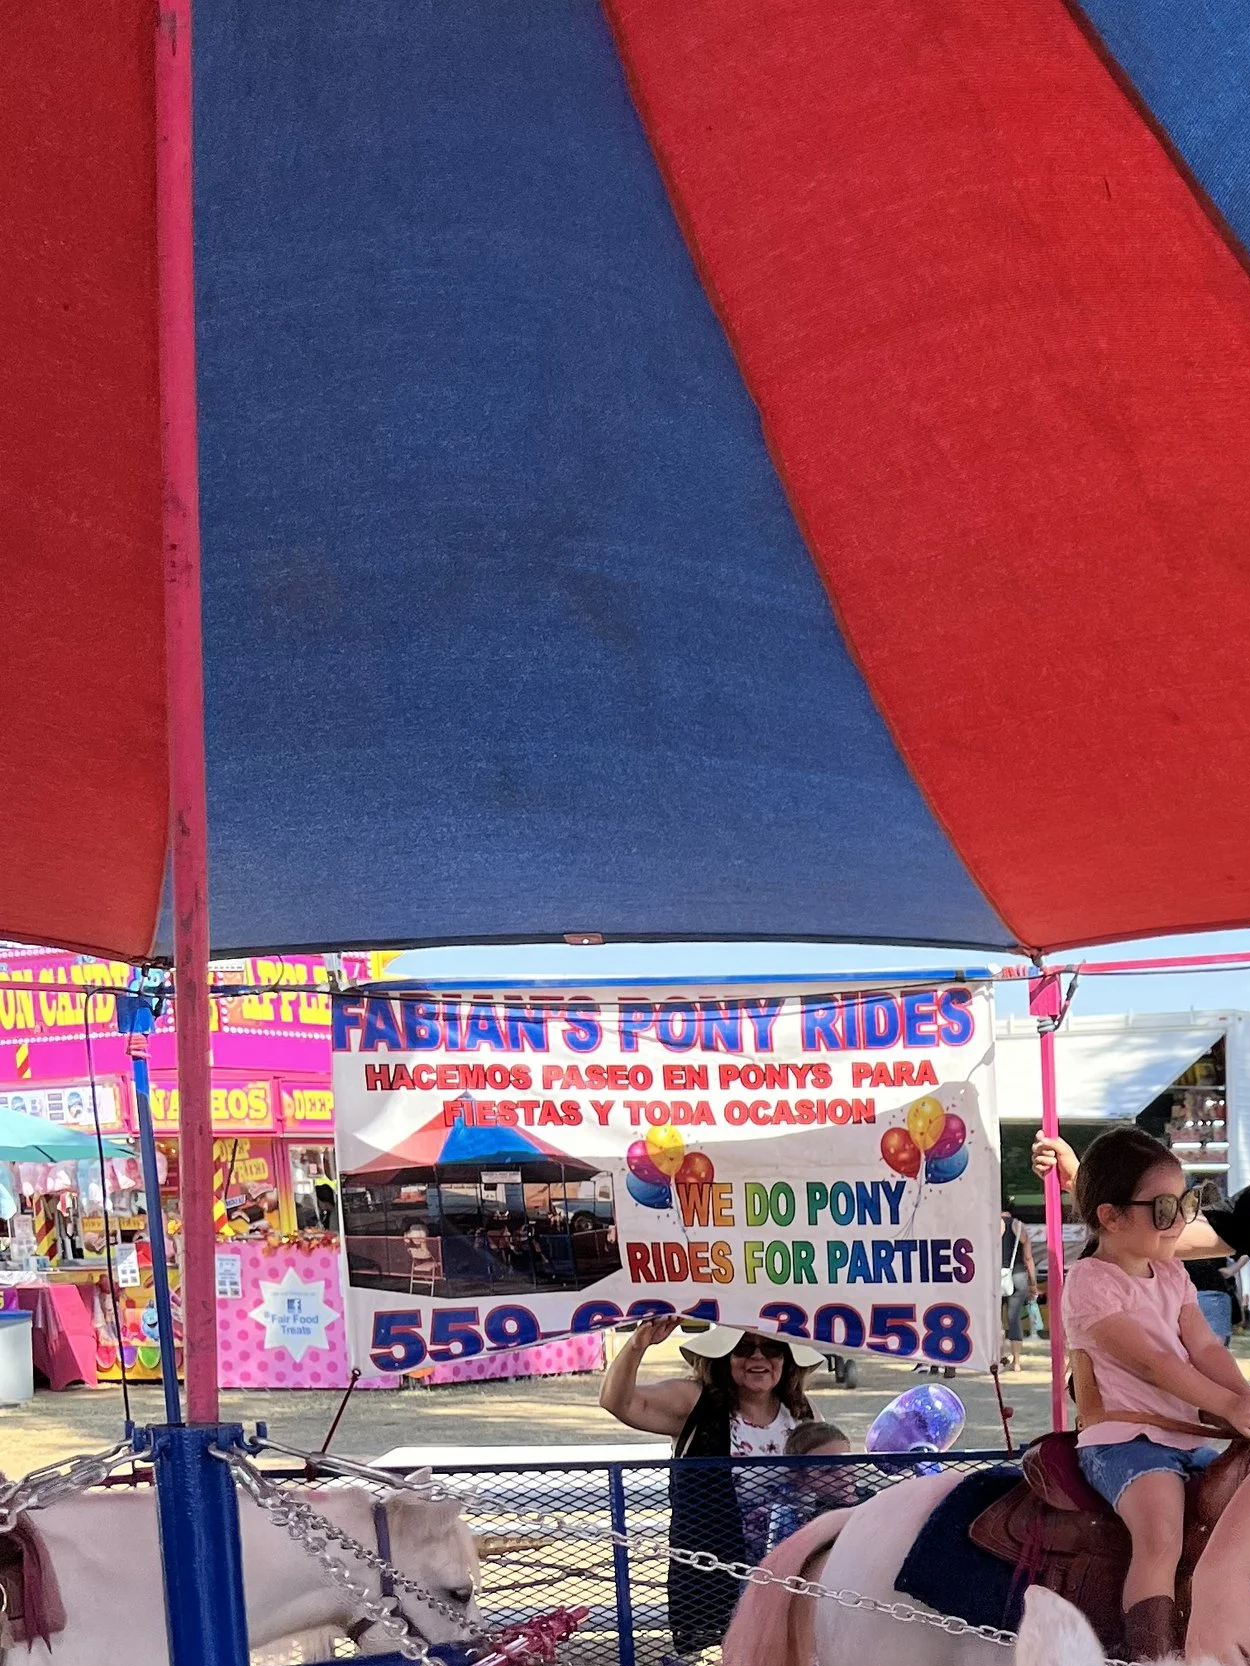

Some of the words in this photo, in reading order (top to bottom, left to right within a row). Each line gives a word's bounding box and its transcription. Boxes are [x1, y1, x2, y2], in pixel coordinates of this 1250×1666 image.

[331, 990, 601, 1053] FABIAN'S
[617, 996, 786, 1053] PONY
[800, 987, 976, 1052] RIDES
[365, 1064, 532, 1091] HACEMOS
[542, 1064, 653, 1090] PASEO
[662, 1064, 709, 1090] EN
[719, 1063, 832, 1090] PONYS
[852, 1060, 939, 1088] PARA
[150, 1088, 268, 1120] NAHOS
[292, 1088, 335, 1120] DEEP
[443, 1099, 582, 1127] FIESTAS
[589, 1100, 616, 1126] Y
[622, 1100, 717, 1126] TODA
[724, 1098, 876, 1126] OCASION
[675, 1181, 736, 1227] WE
[744, 1181, 796, 1227] DO
[807, 1181, 907, 1227] PONY
[626, 1240, 735, 1284] RIDES
[744, 1240, 818, 1284] FOR
[827, 1238, 975, 1284] PARTIES
[281, 1325, 311, 1335] Treats
[293, 1314, 319, 1323] Food
